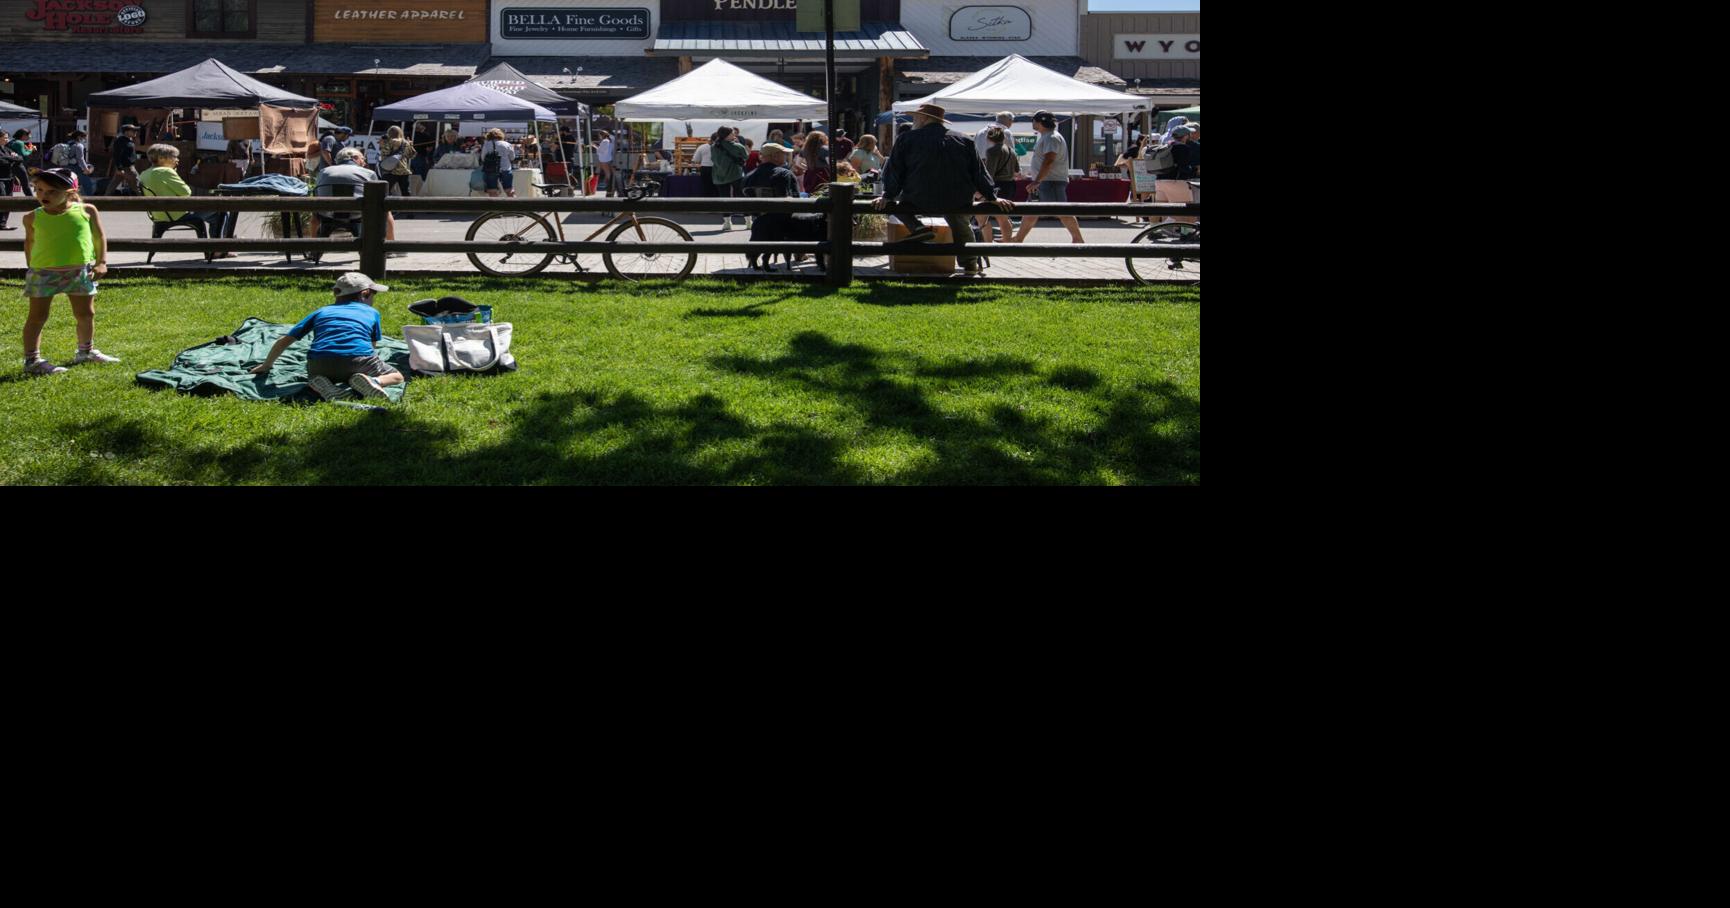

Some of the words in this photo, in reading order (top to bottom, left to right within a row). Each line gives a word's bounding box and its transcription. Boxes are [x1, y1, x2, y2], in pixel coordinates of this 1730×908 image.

[117, 10, 146, 22] LOGO
[334, 10, 398, 19] LEATHER
[400, 10, 465, 19] APPAREL
[508, 14, 561, 25] BELLA
[566, 14, 595, 25] Fine
[599, 14, 644, 25] Goods
[43, 12, 112, 30] HOLE
[1124, 40, 1200, 53] WYO
